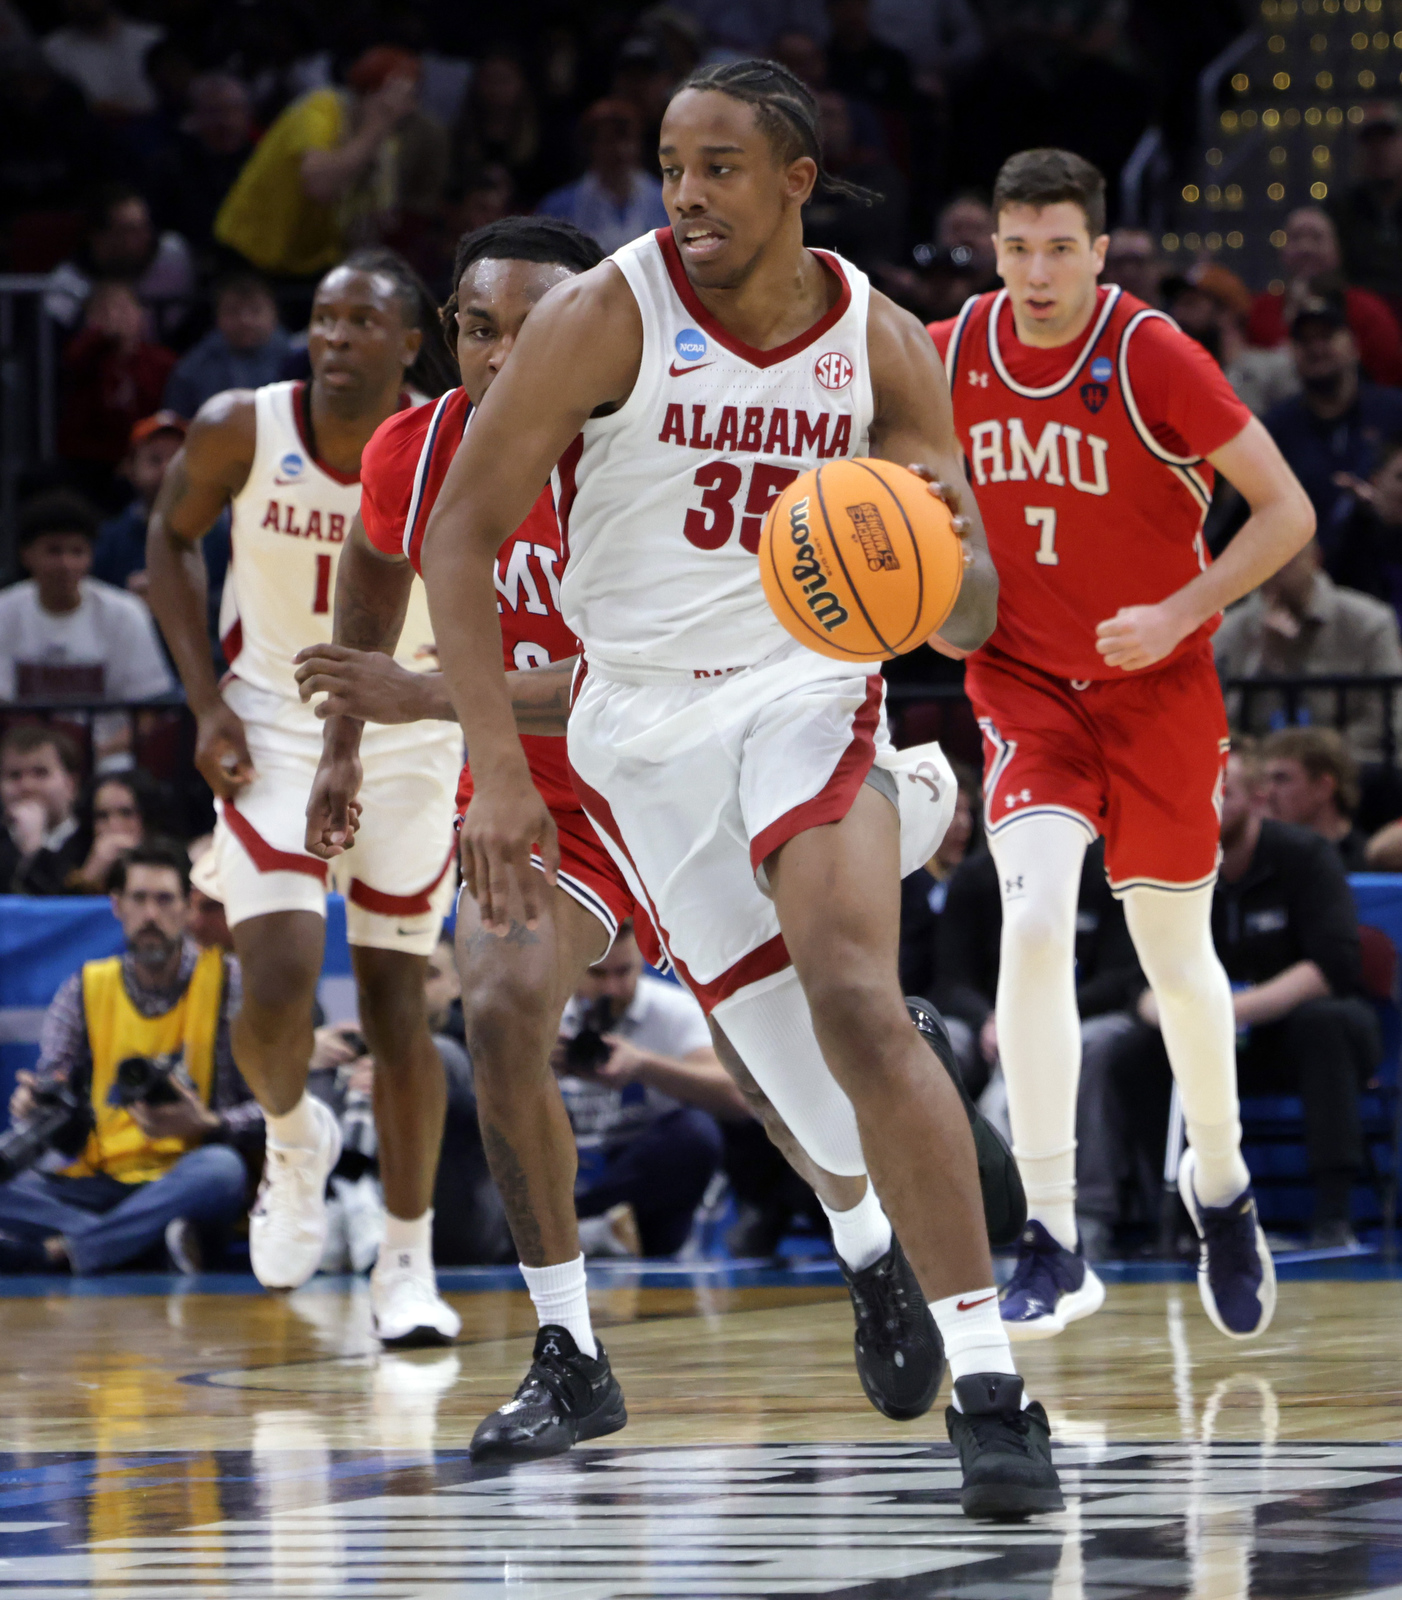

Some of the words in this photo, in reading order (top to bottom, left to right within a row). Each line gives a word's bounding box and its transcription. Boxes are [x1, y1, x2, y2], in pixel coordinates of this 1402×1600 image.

[680, 343, 705, 353] NCAA
[817, 353, 851, 388] SEC
[658, 403, 852, 458] ALABAMA
[969, 418, 1110, 496] RMU
[262, 500, 345, 544] ALAB
[855, 521, 880, 560] MARCH
[860, 503, 890, 552] MADNESS
[1024, 505, 1059, 566] 7
[788, 496, 850, 633] Wilson
